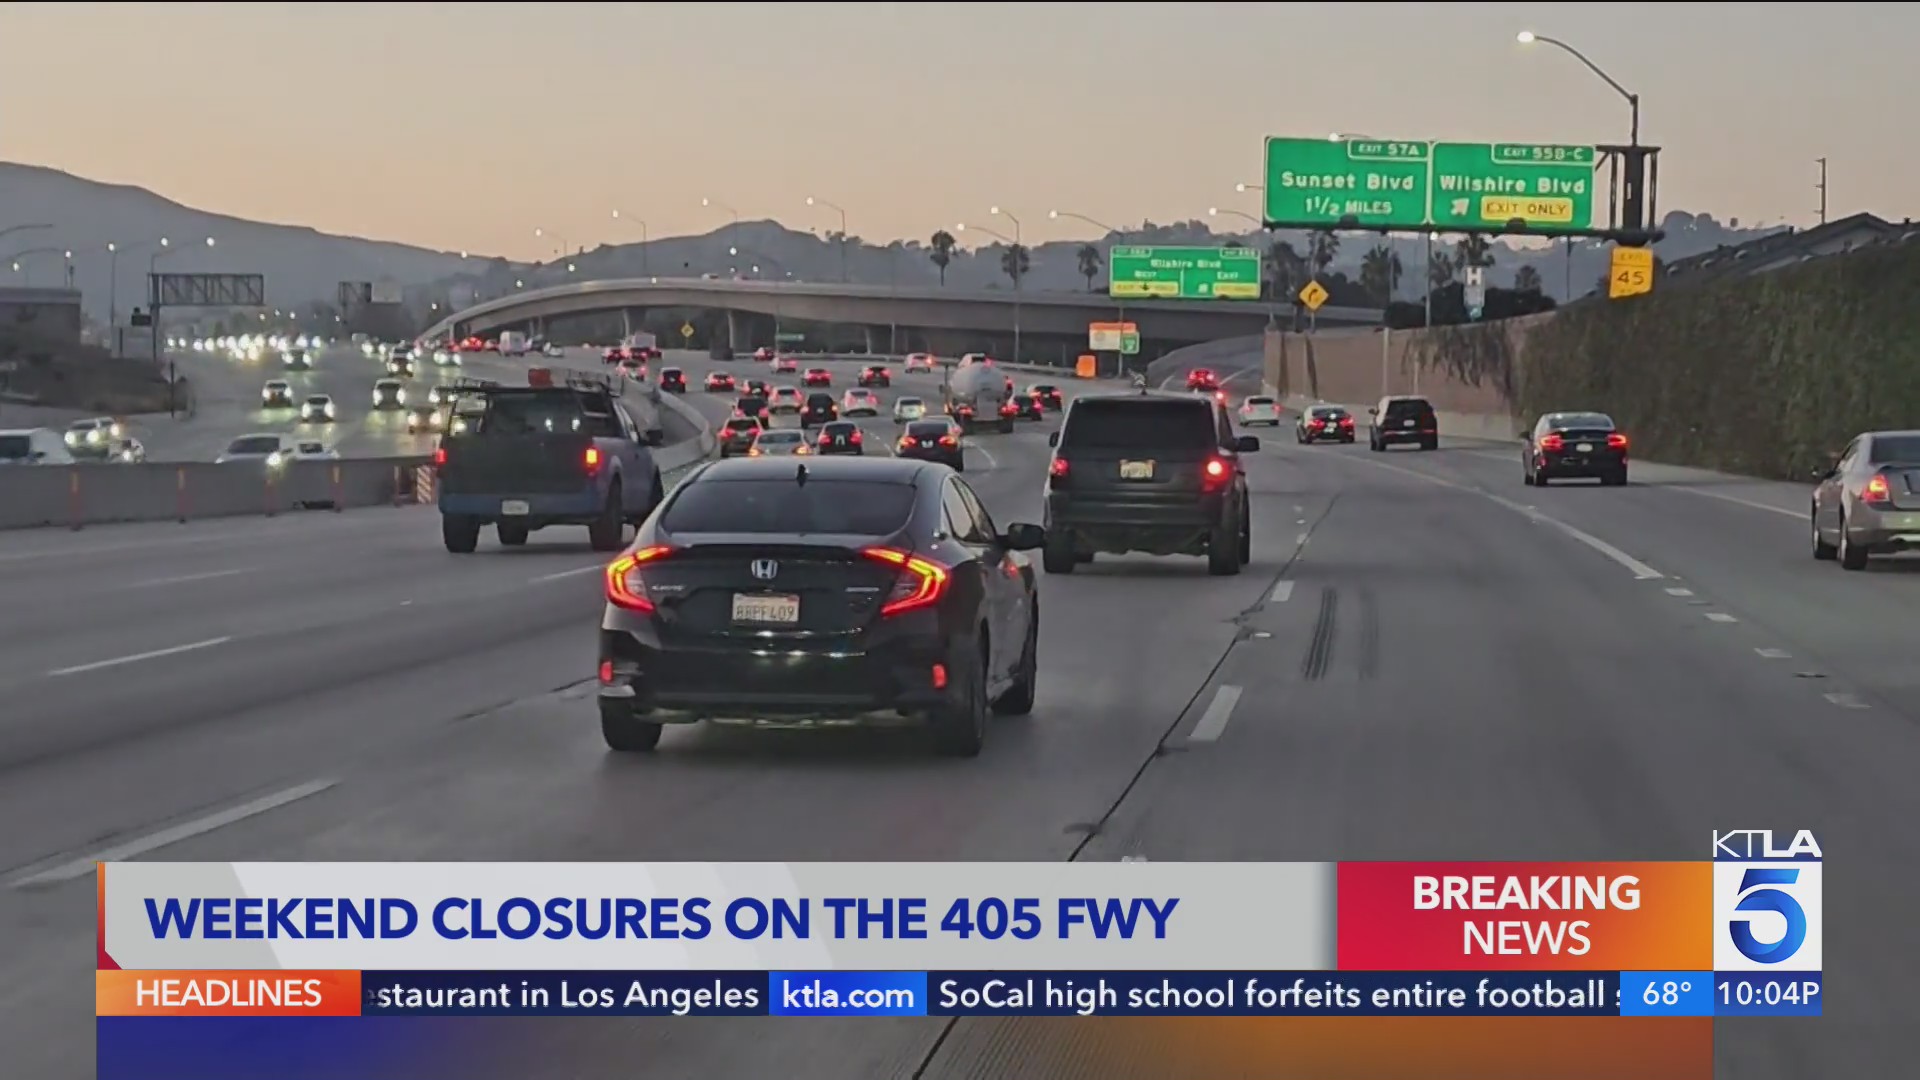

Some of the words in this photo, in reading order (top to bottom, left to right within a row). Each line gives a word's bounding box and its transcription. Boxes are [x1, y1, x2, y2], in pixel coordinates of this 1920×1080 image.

[1388, 143, 1419, 156] 57A
[1281, 171, 1356, 189] Sunset
[1366, 173, 1414, 190] Blvd
[1439, 175, 1527, 193] Wilshire
[1537, 177, 1586, 194] Blvd
[1345, 200, 1393, 214] MILES
[1486, 202, 1519, 214] EXIT
[1527, 204, 1568, 215] ONLY
[1617, 270, 1645, 286] 45
